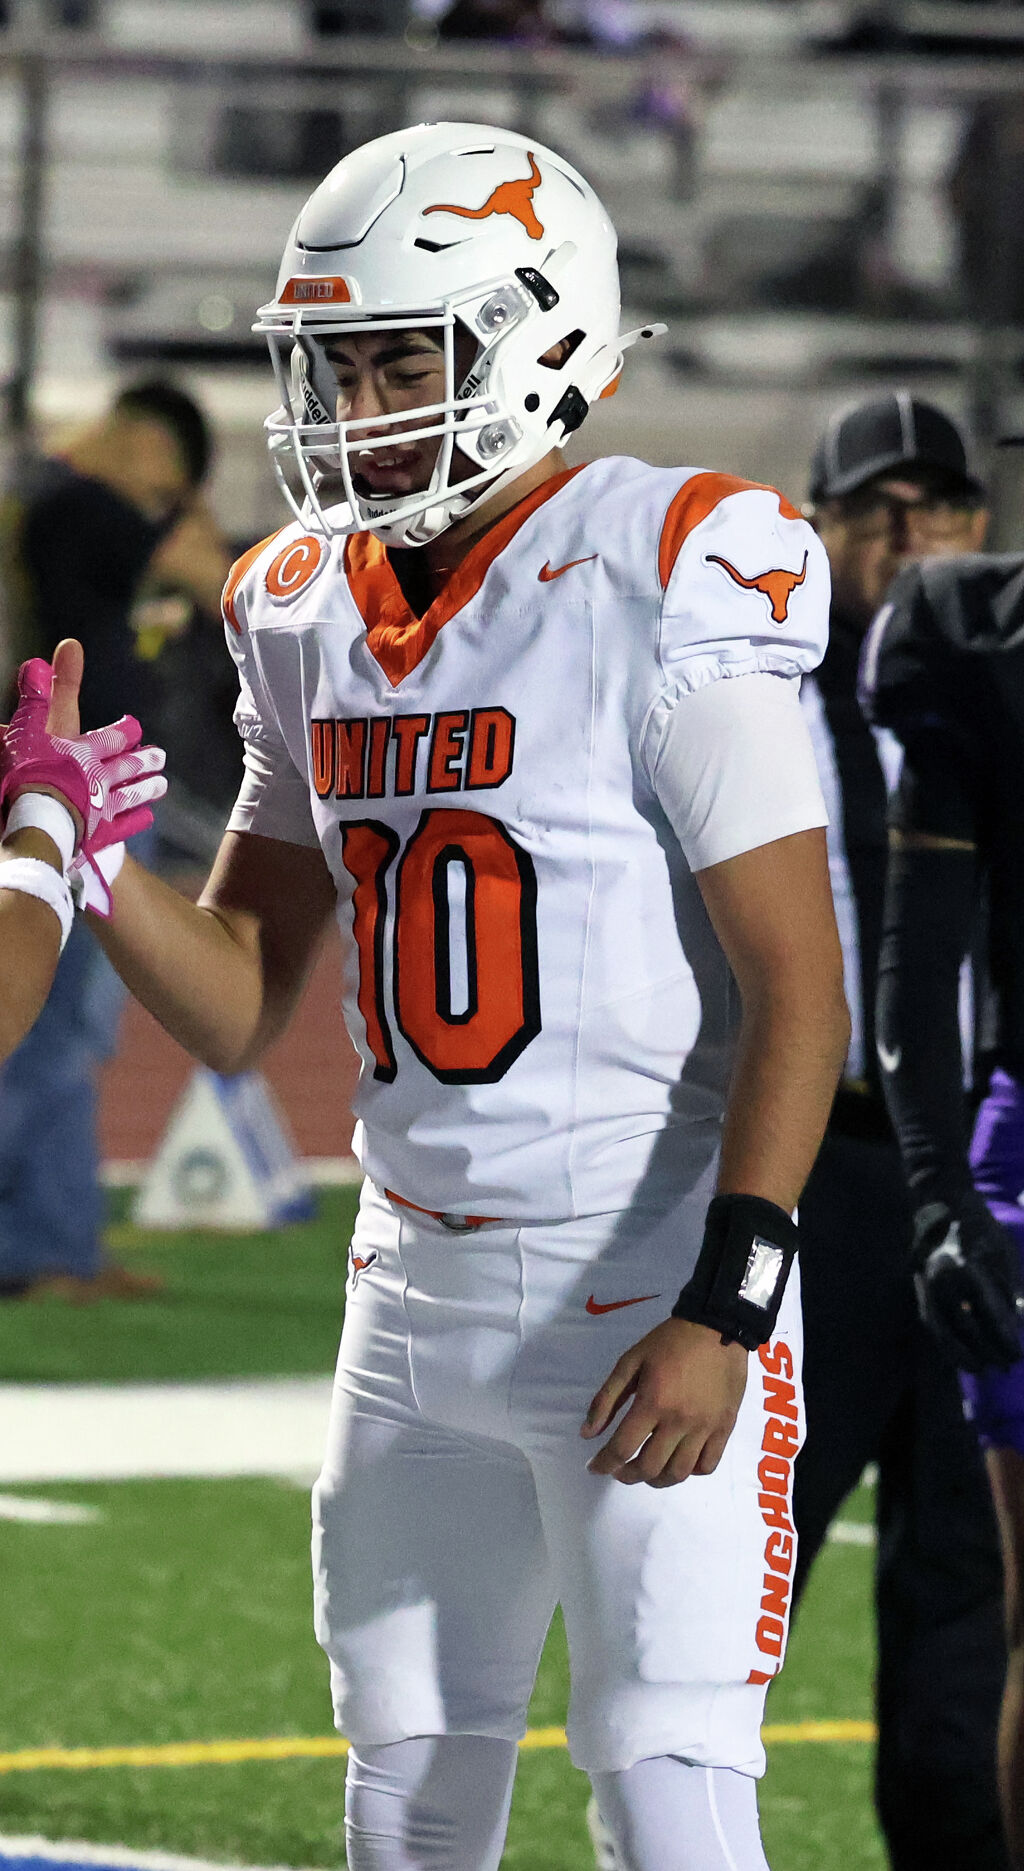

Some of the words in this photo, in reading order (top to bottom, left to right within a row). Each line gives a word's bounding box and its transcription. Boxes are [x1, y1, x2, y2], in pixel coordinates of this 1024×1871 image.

[294, 282, 334, 299] UNITED
[277, 544, 311, 588] C
[311, 706, 516, 800] UNITED
[340, 808, 542, 1085] 10
[746, 1340, 800, 1685] LONGHORNS
